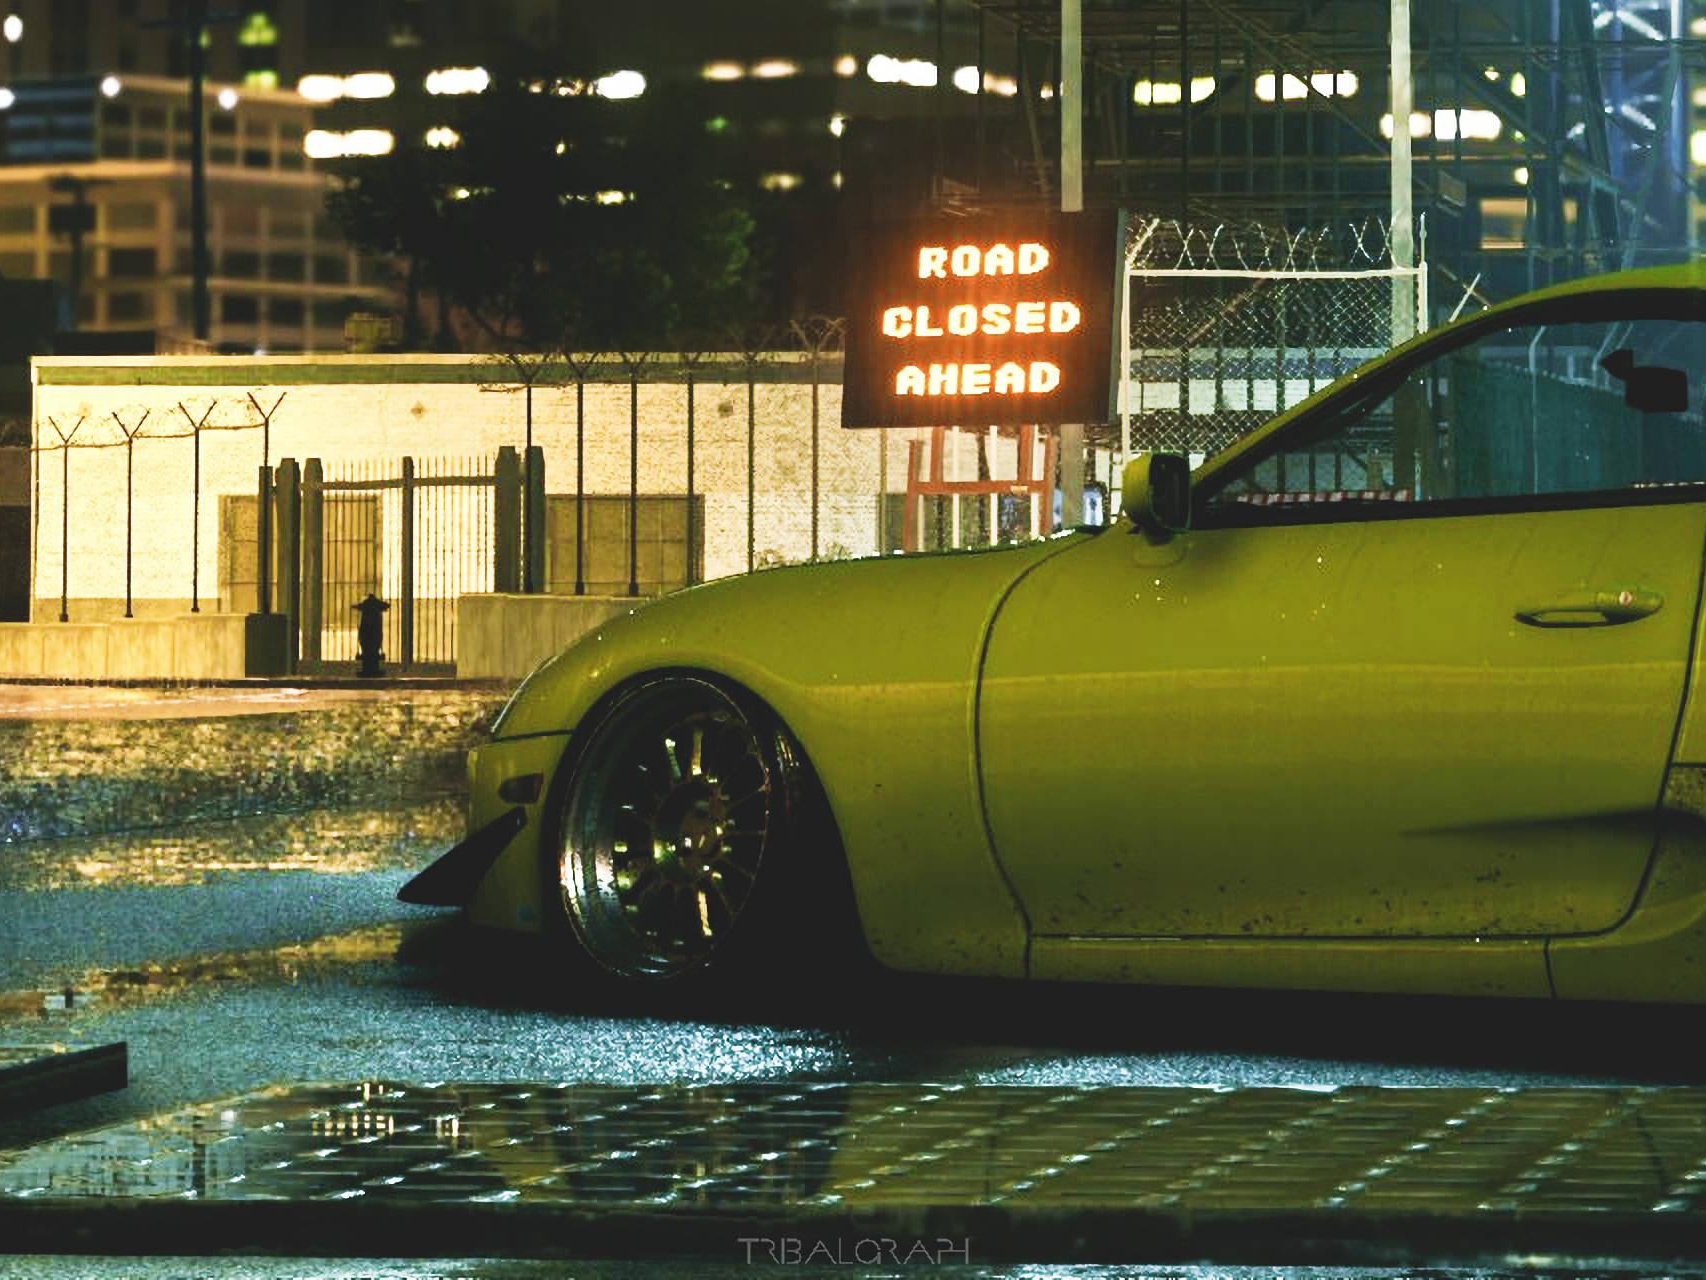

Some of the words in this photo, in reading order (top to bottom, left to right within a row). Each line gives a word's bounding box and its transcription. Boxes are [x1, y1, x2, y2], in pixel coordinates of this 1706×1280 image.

[918, 243, 1050, 278] ROAD
[882, 302, 1081, 338] CLOSED
[895, 362, 1061, 396] AHEAD
